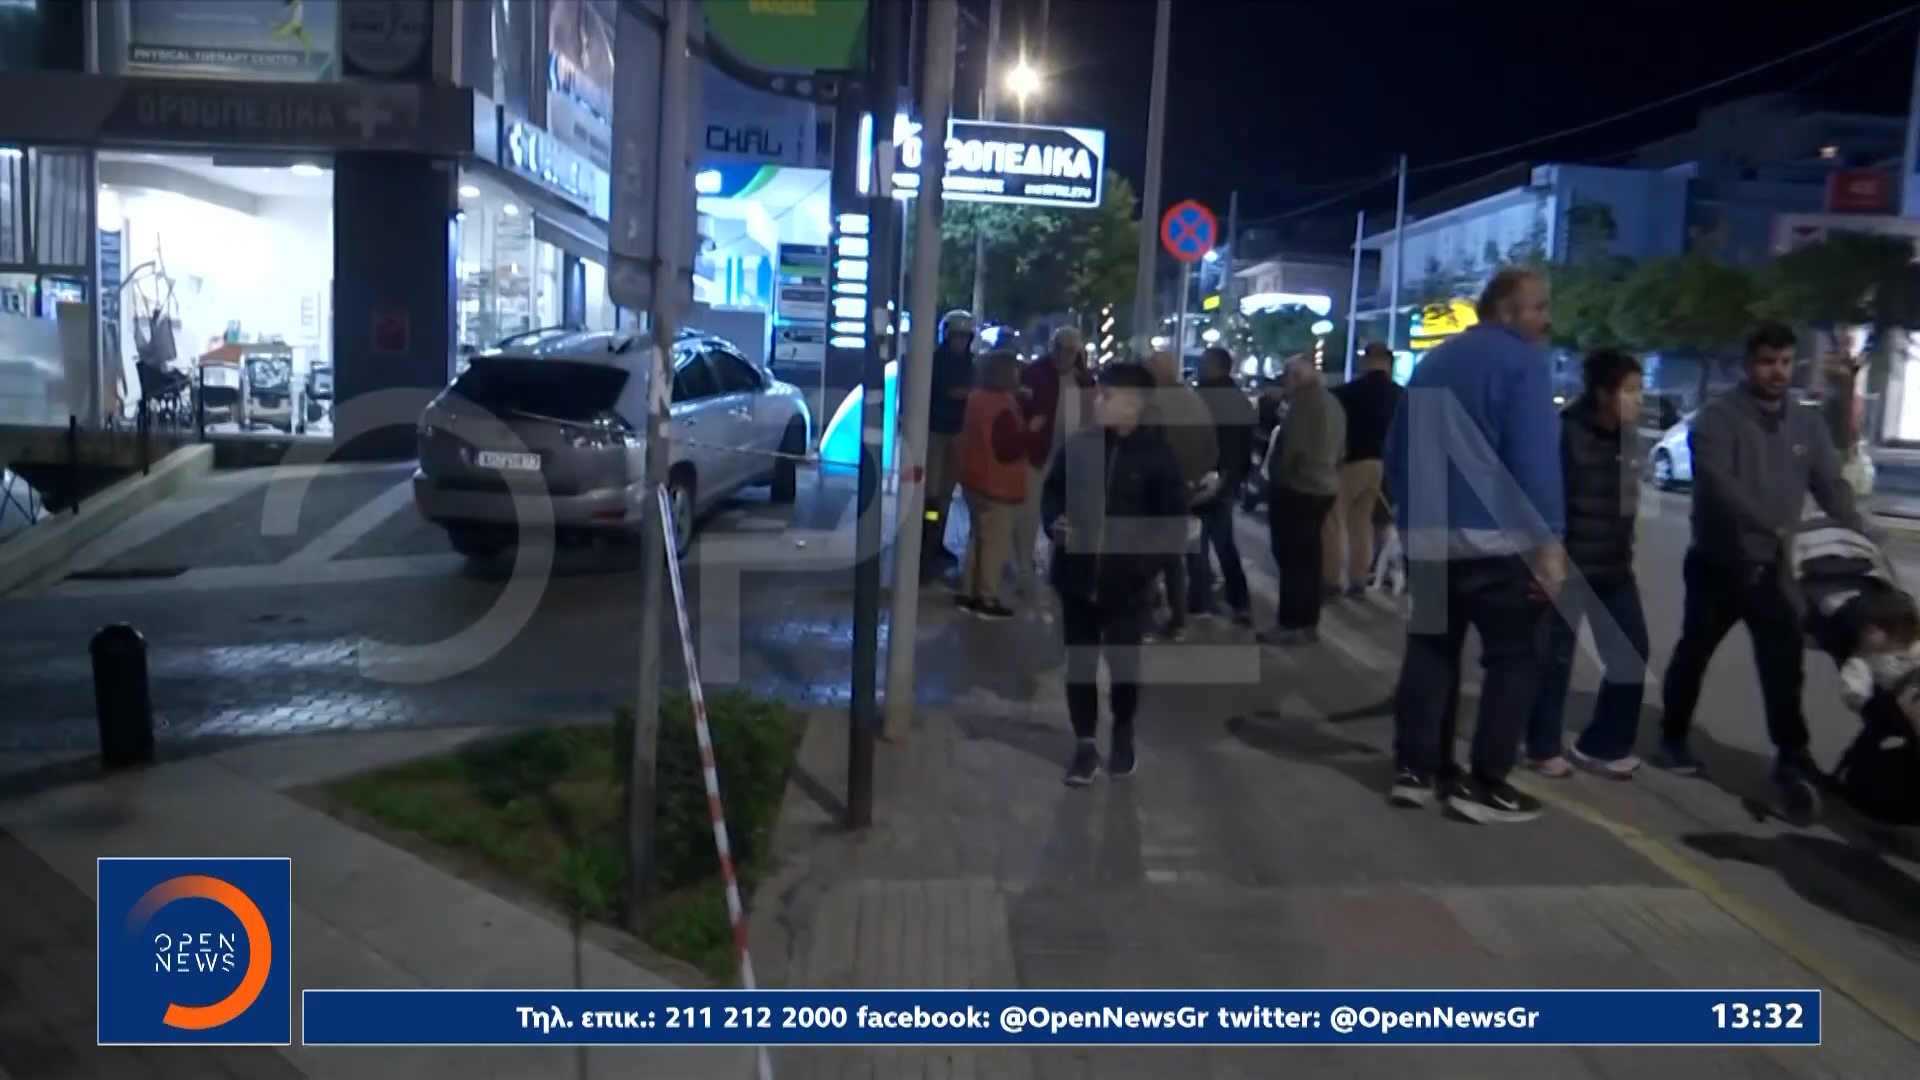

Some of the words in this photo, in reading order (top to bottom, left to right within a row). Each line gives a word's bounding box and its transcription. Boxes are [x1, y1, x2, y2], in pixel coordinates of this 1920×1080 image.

[133, 47, 190, 61] PHYSICAL
[194, 51, 249, 63] THERAPY
[251, 53, 298, 65] CENTER
[138, 92, 335, 129] ΟΡΘΟΠΕΔΙΚΑ
[902, 136, 1092, 179] ΟΘΟΠΕΔΙΚΑ
